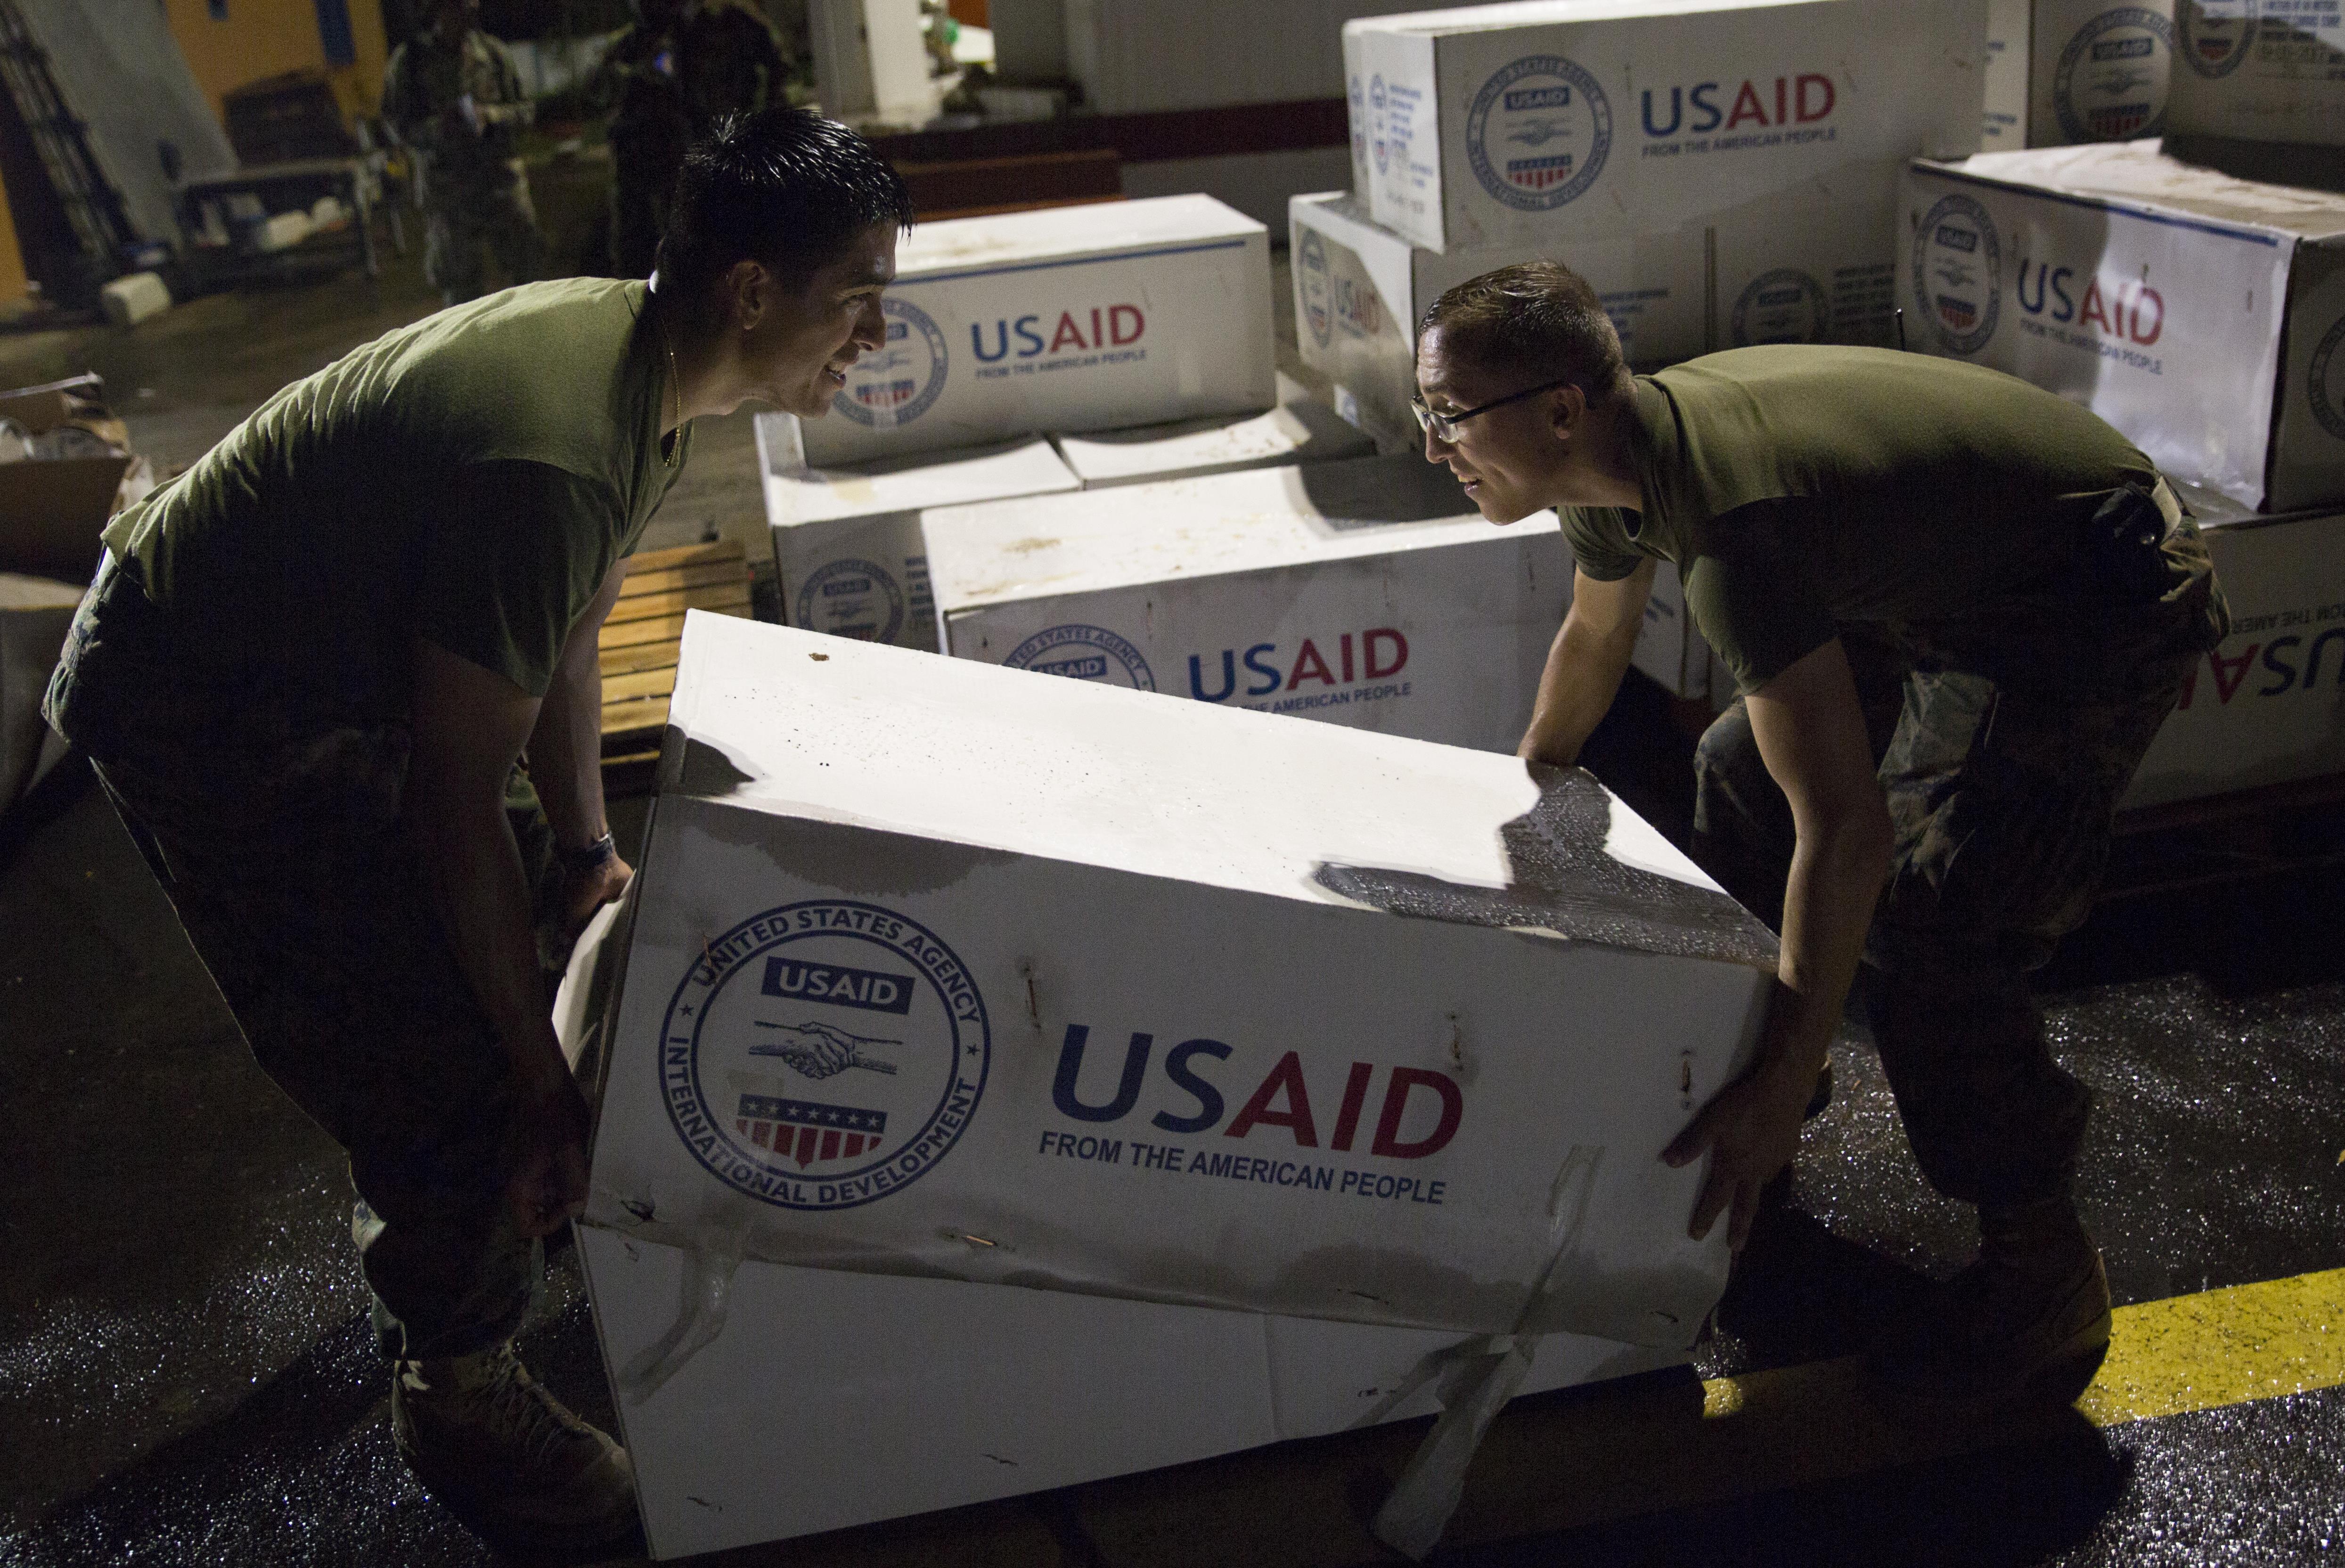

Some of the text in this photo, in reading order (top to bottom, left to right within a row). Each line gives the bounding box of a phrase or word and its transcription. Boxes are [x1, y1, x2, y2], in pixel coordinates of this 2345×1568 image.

[1510, 91, 1565, 107] USAID
[1642, 73, 1837, 138] USAID
[1642, 127, 1837, 158] FROM THE AMERICAN PEOPLE
[2018, 258, 2165, 346] USAID
[971, 304, 1145, 362] USAID
[976, 349, 1146, 379] FROM THE AMERICAN PEOPLE
[2122, 349, 2164, 376] PEOPLE
[2281, 609, 2310, 627] THE
[1038, 629, 1090, 648] STATES
[1095, 632, 1145, 670] AGENCY
[1188, 628, 1409, 702] USAID
[2178, 627, 2345, 711] USAI
[1273, 691, 1350, 713] AMERICAN
[1354, 682, 1412, 702] PEOPLE
[692, 907, 980, 1023] UNITED STATES AGENCY
[778, 965, 899, 1005] USAID
[667, 1036, 977, 1203] INTERNATIONAL DEVELOPMENT
[1052, 1024, 1463, 1160] USAID
[1038, 1130, 1446, 1205] FROM THE AMERICAN PEOPLE
